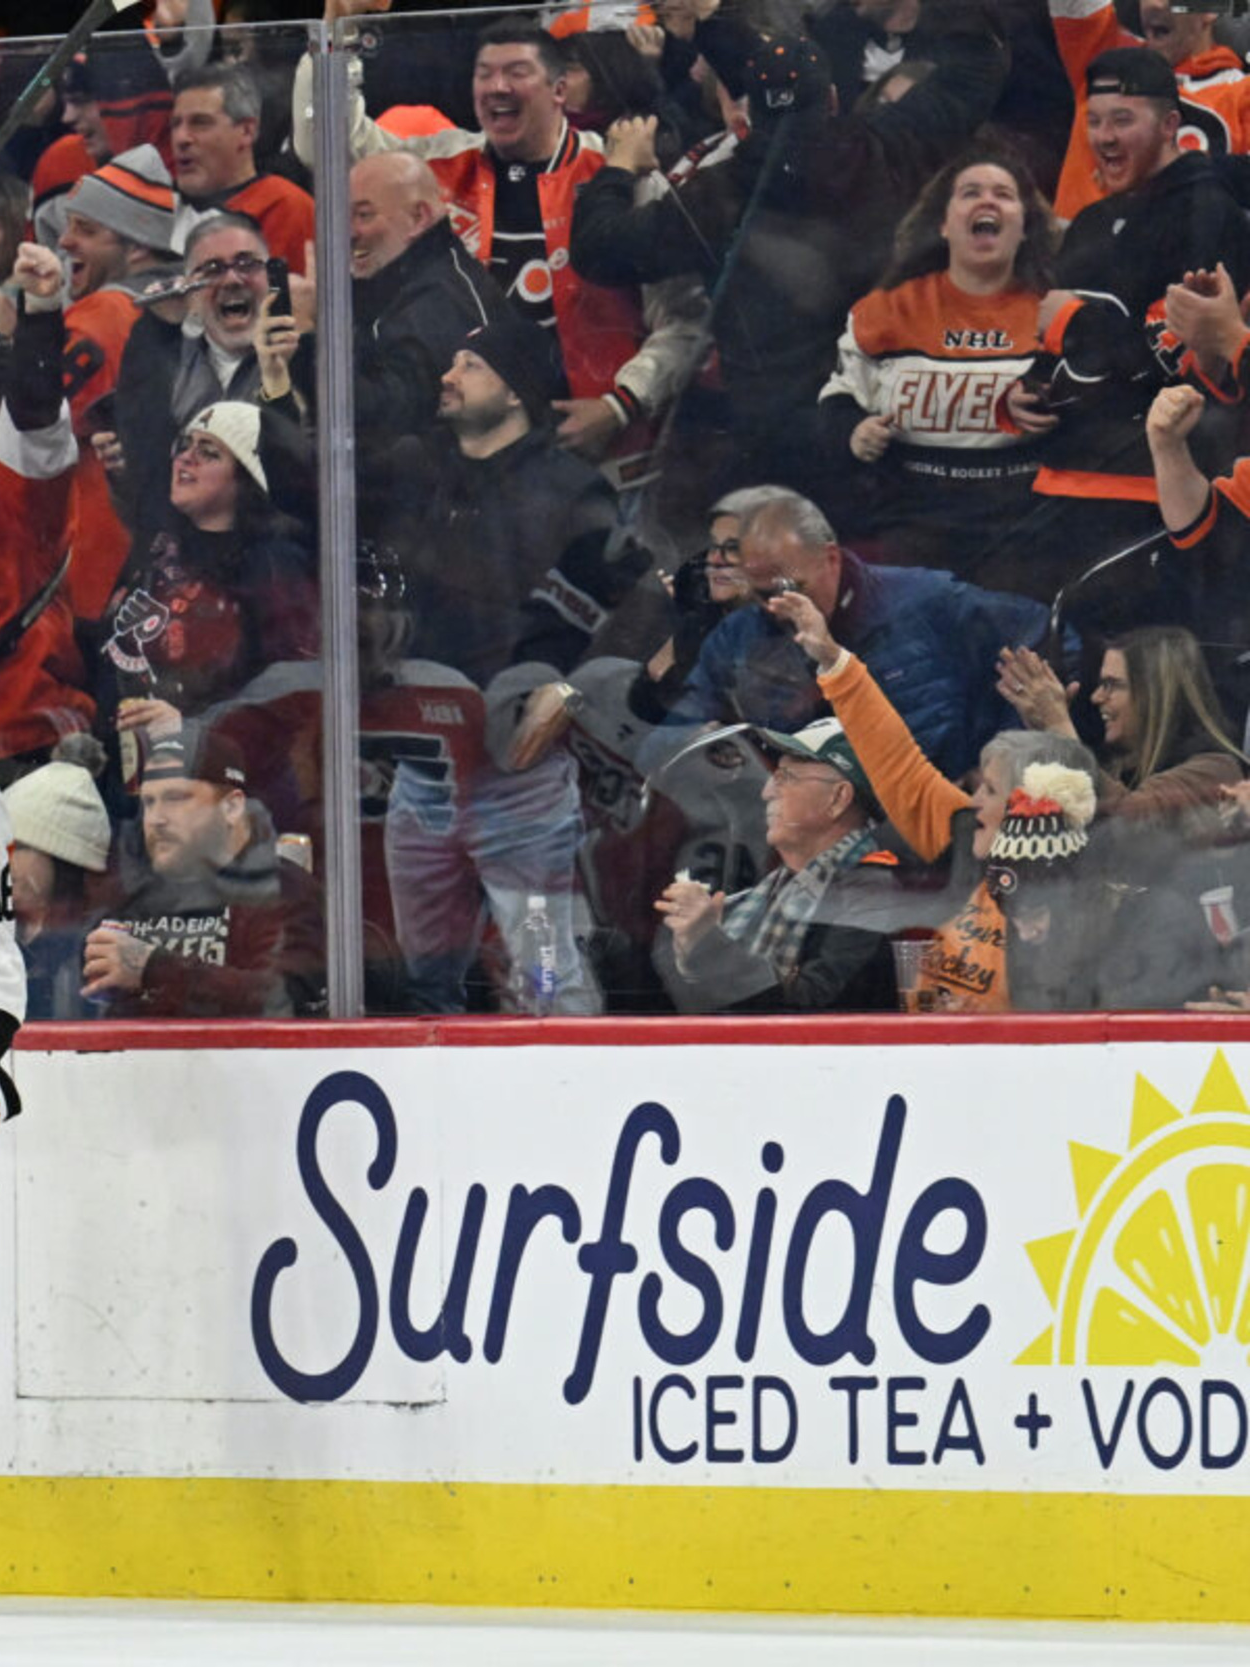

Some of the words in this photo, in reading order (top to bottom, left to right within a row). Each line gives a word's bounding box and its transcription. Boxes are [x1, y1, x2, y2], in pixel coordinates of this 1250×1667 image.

[942, 328, 1014, 350] NHL
[892, 370, 1018, 433] FLYE
[251, 1070, 991, 1405] Surfside
[633, 1374, 798, 1464] ICED
[829, 1376, 985, 1466] TEA
